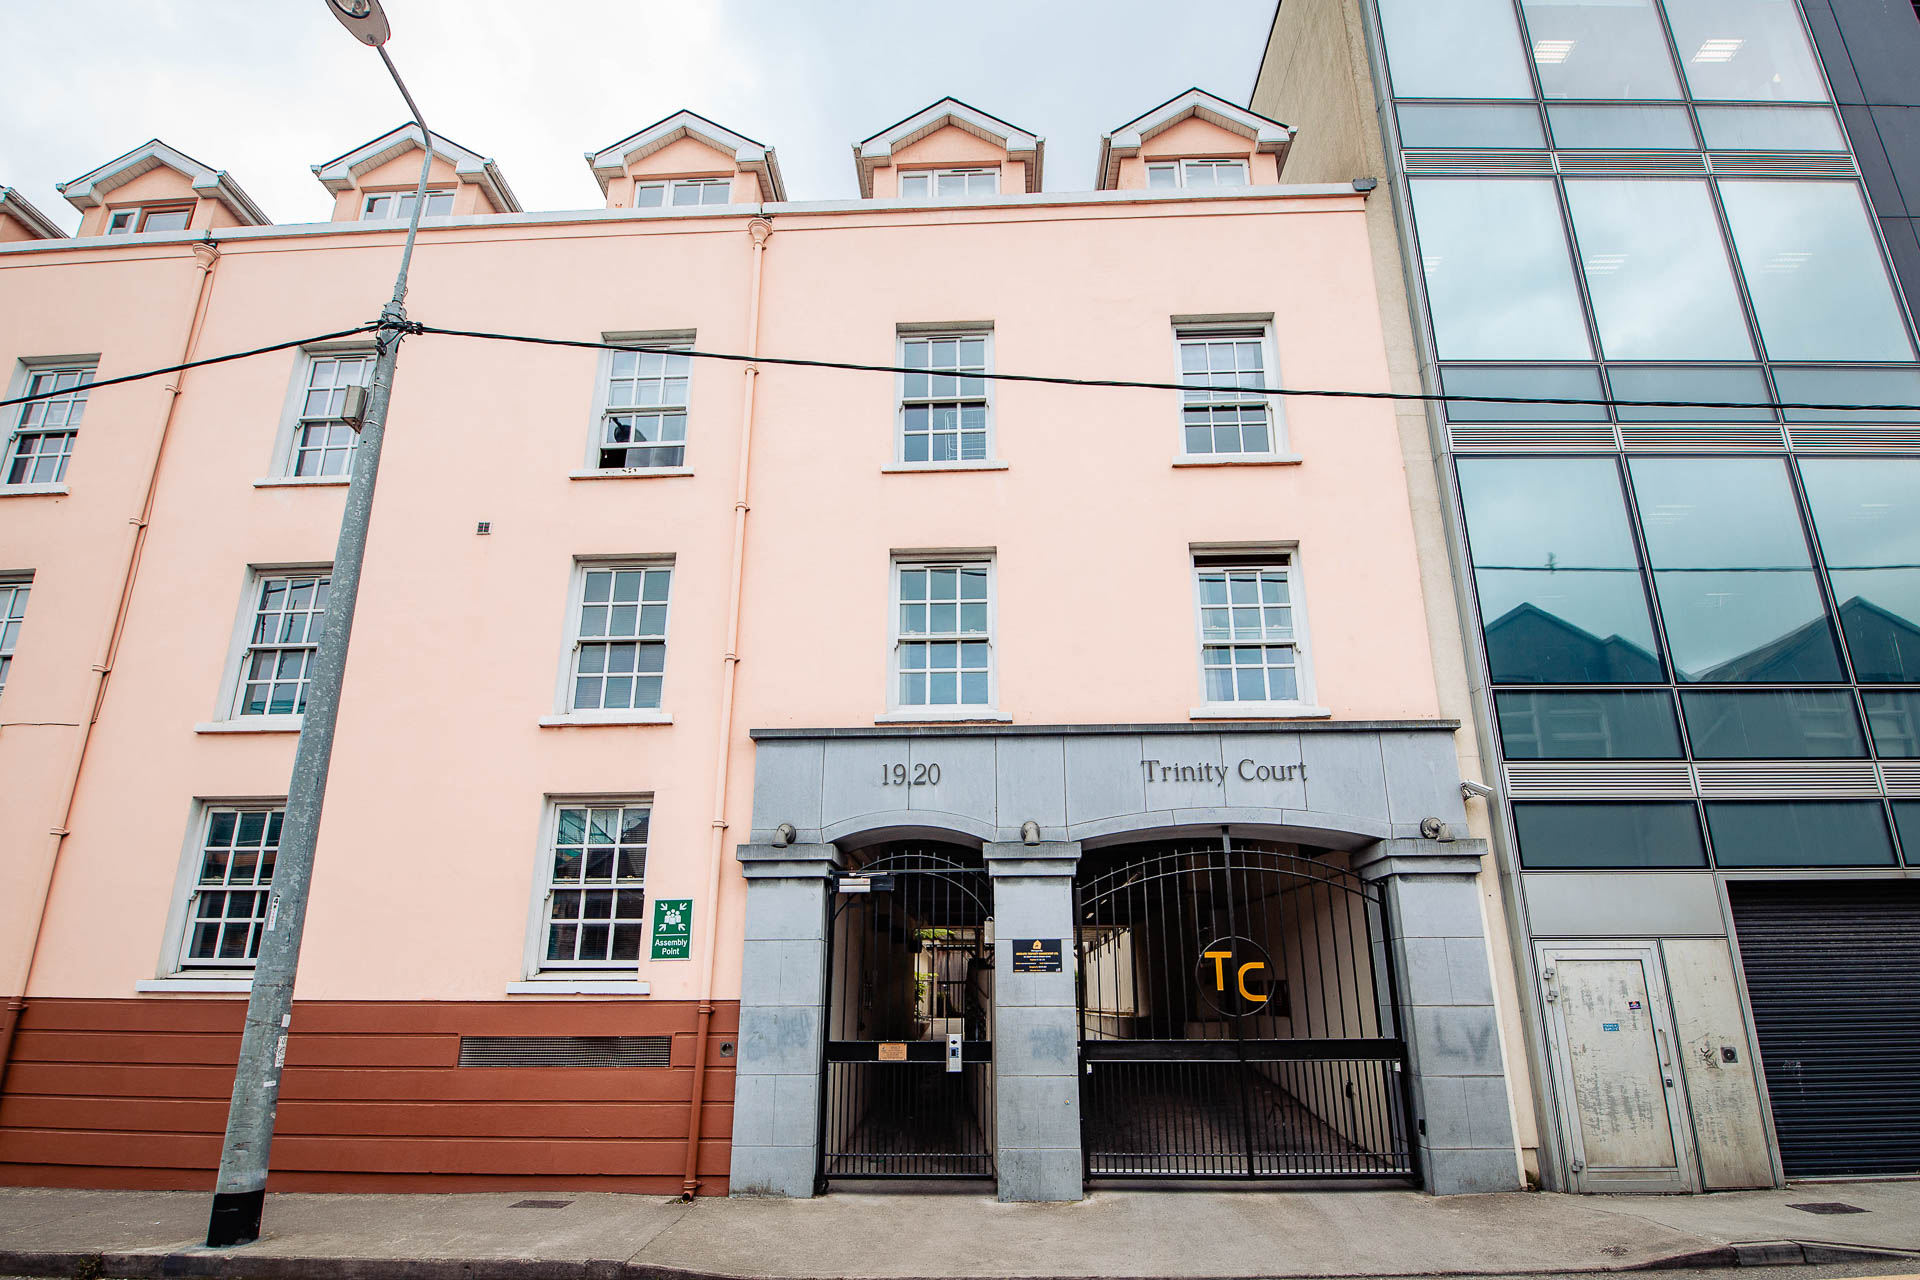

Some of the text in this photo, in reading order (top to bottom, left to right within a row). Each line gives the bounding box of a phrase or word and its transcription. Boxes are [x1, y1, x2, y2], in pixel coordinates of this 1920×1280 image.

[1140, 758, 1308, 788] Trinity Court
[654, 938, 688, 948] Assembly
[661, 947, 680, 955] Point
[1204, 951, 1268, 1002] TC
